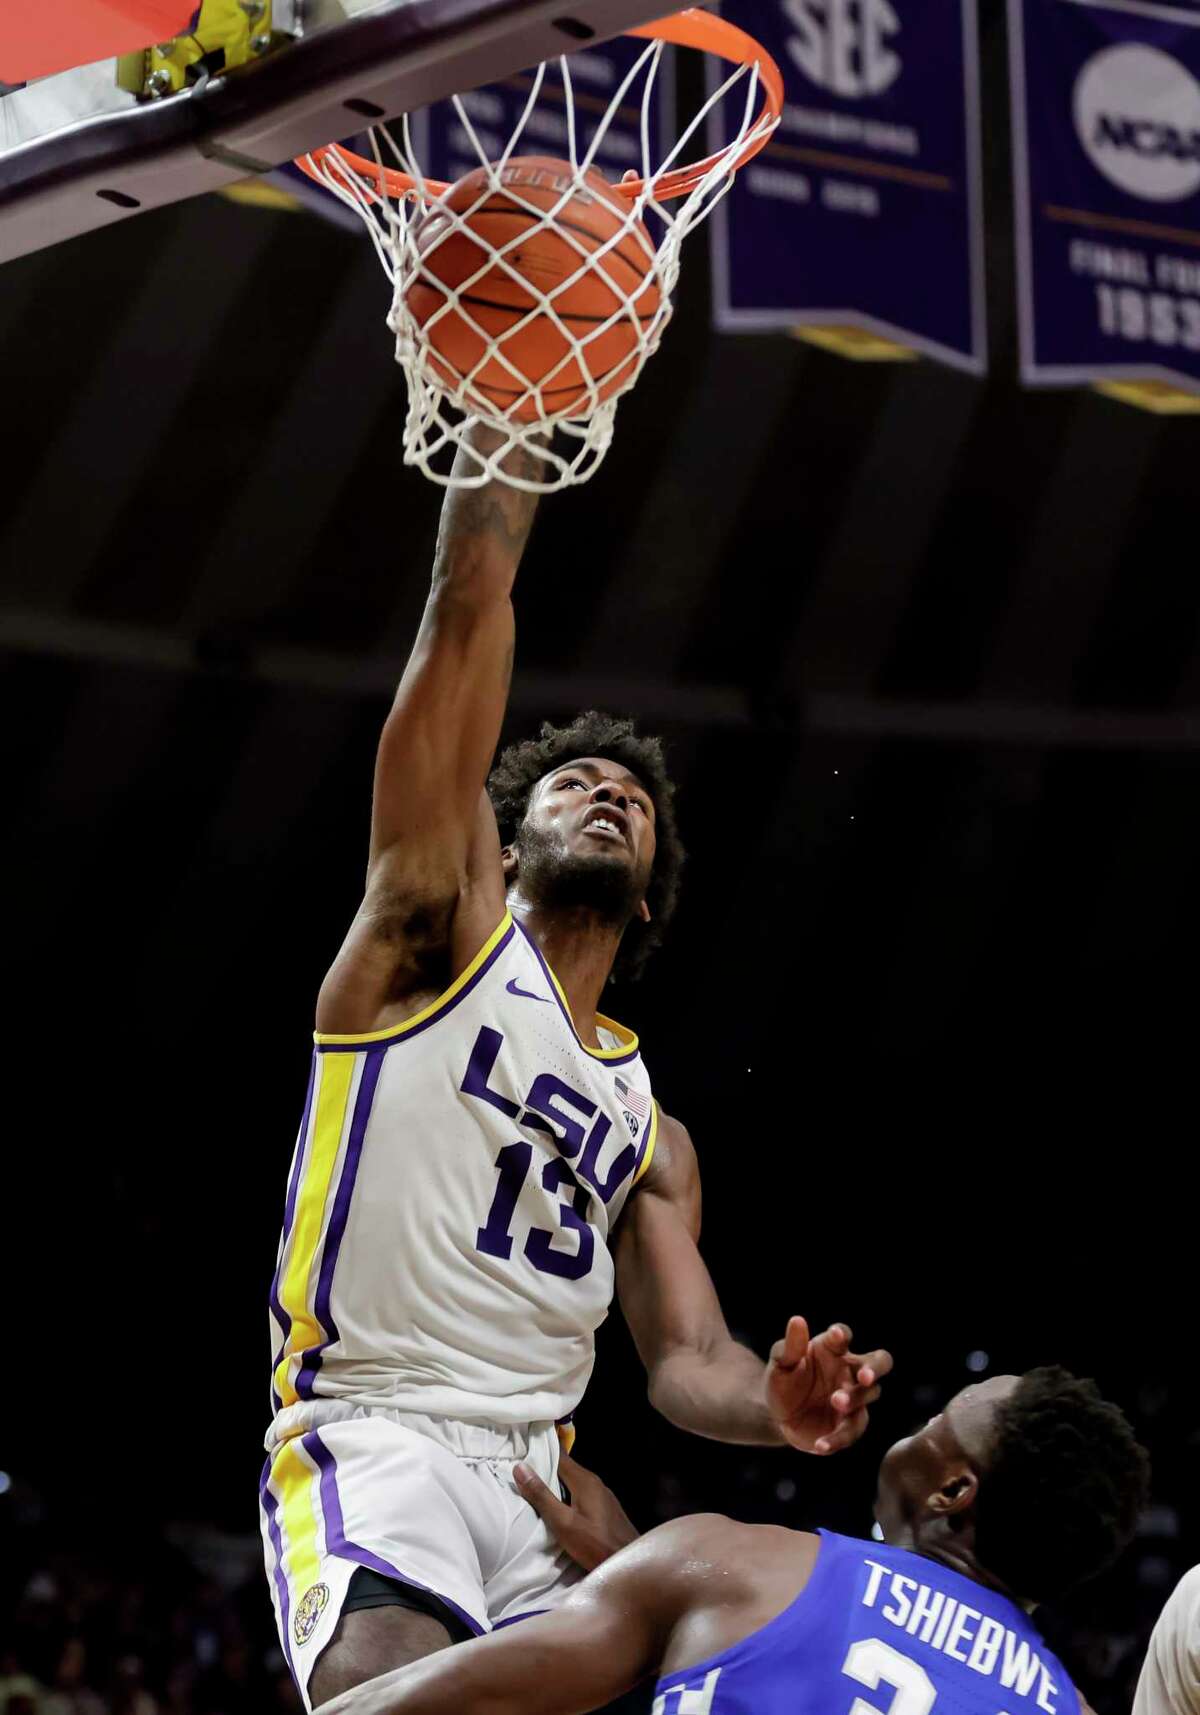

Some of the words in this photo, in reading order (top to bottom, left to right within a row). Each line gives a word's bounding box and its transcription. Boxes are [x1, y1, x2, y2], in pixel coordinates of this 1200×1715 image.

[779, 0, 901, 97] SEC
[460, 1025, 636, 1203] LSU
[476, 1141, 594, 1280] 13
[863, 1559, 1059, 1714] TSHIEBWE
